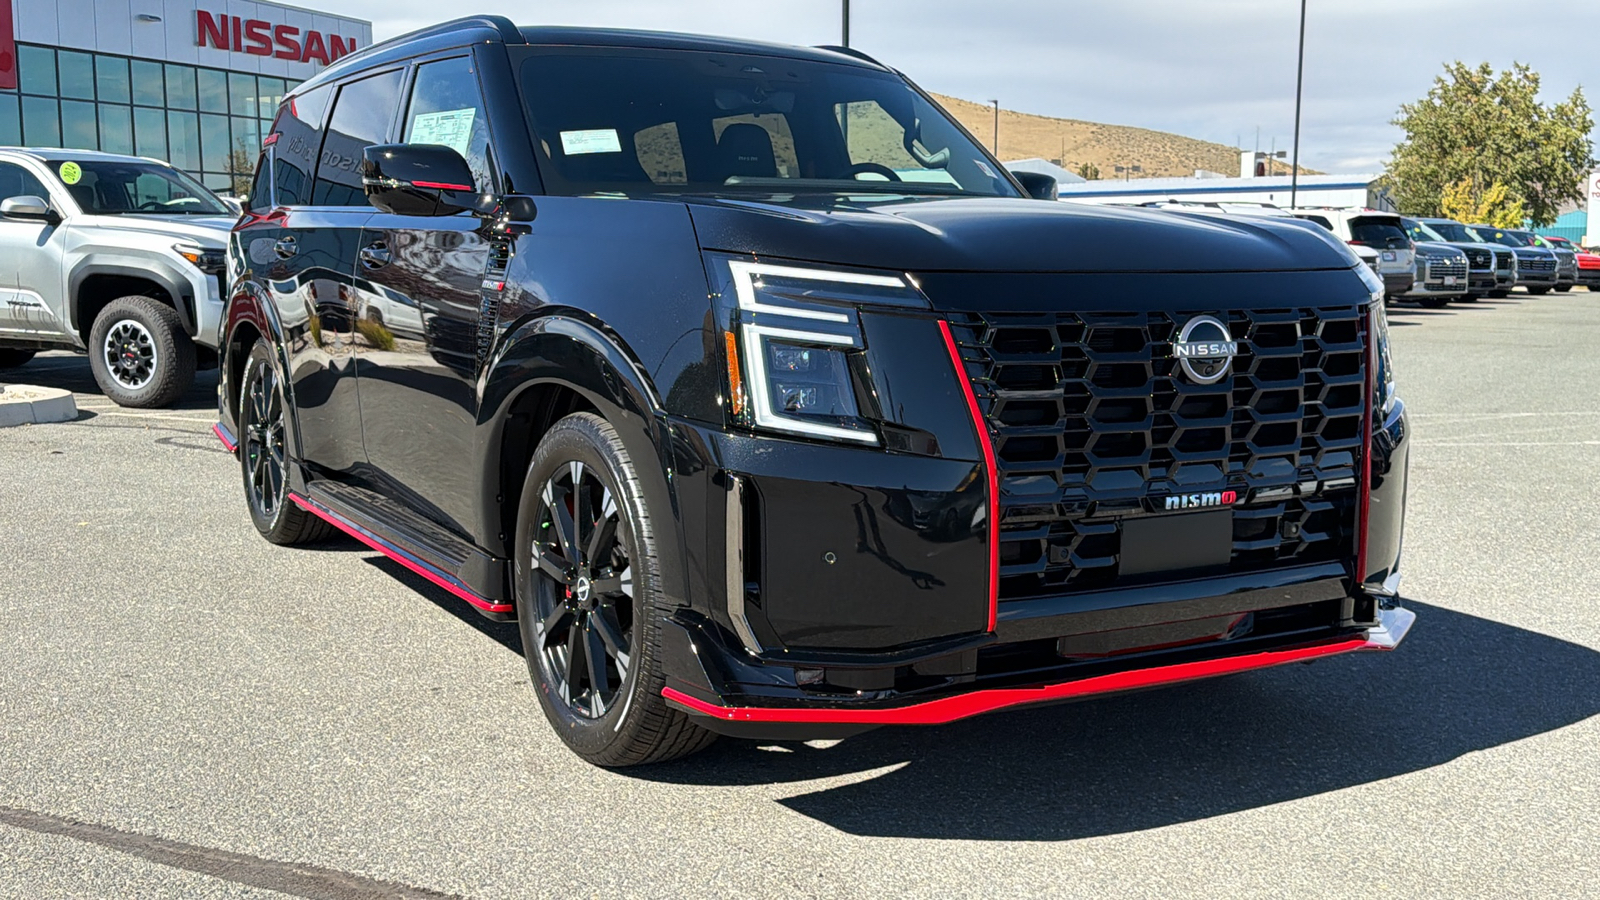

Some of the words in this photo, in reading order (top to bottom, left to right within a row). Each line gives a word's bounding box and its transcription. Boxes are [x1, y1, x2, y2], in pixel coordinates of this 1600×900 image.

[196, 9, 357, 67] NISSAN
[1176, 343, 1237, 356] NISSAN
[1165, 490, 1237, 510] nismo
